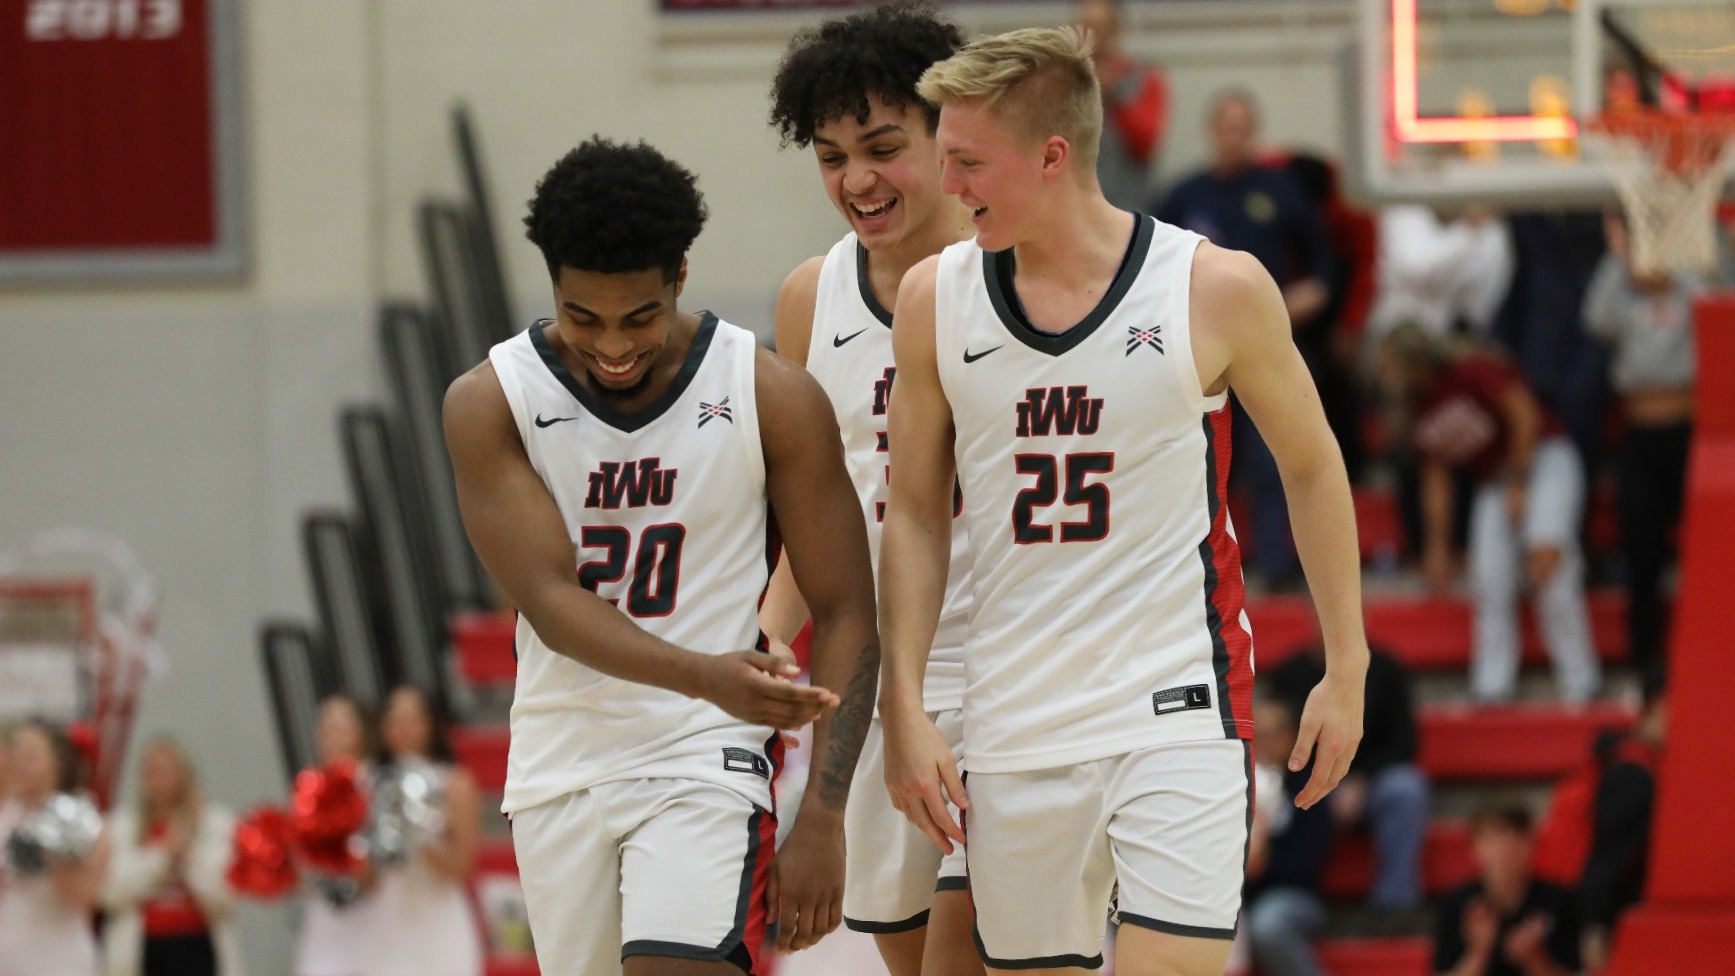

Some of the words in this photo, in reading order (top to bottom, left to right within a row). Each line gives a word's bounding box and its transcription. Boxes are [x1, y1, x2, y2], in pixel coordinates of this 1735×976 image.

[26, 0, 182, 41] 2013
[1016, 385, 1104, 437] IWU
[584, 457, 677, 509] IWU
[1012, 452, 1114, 544] 25
[577, 522, 686, 618] 20
[1193, 692, 1202, 701] L
